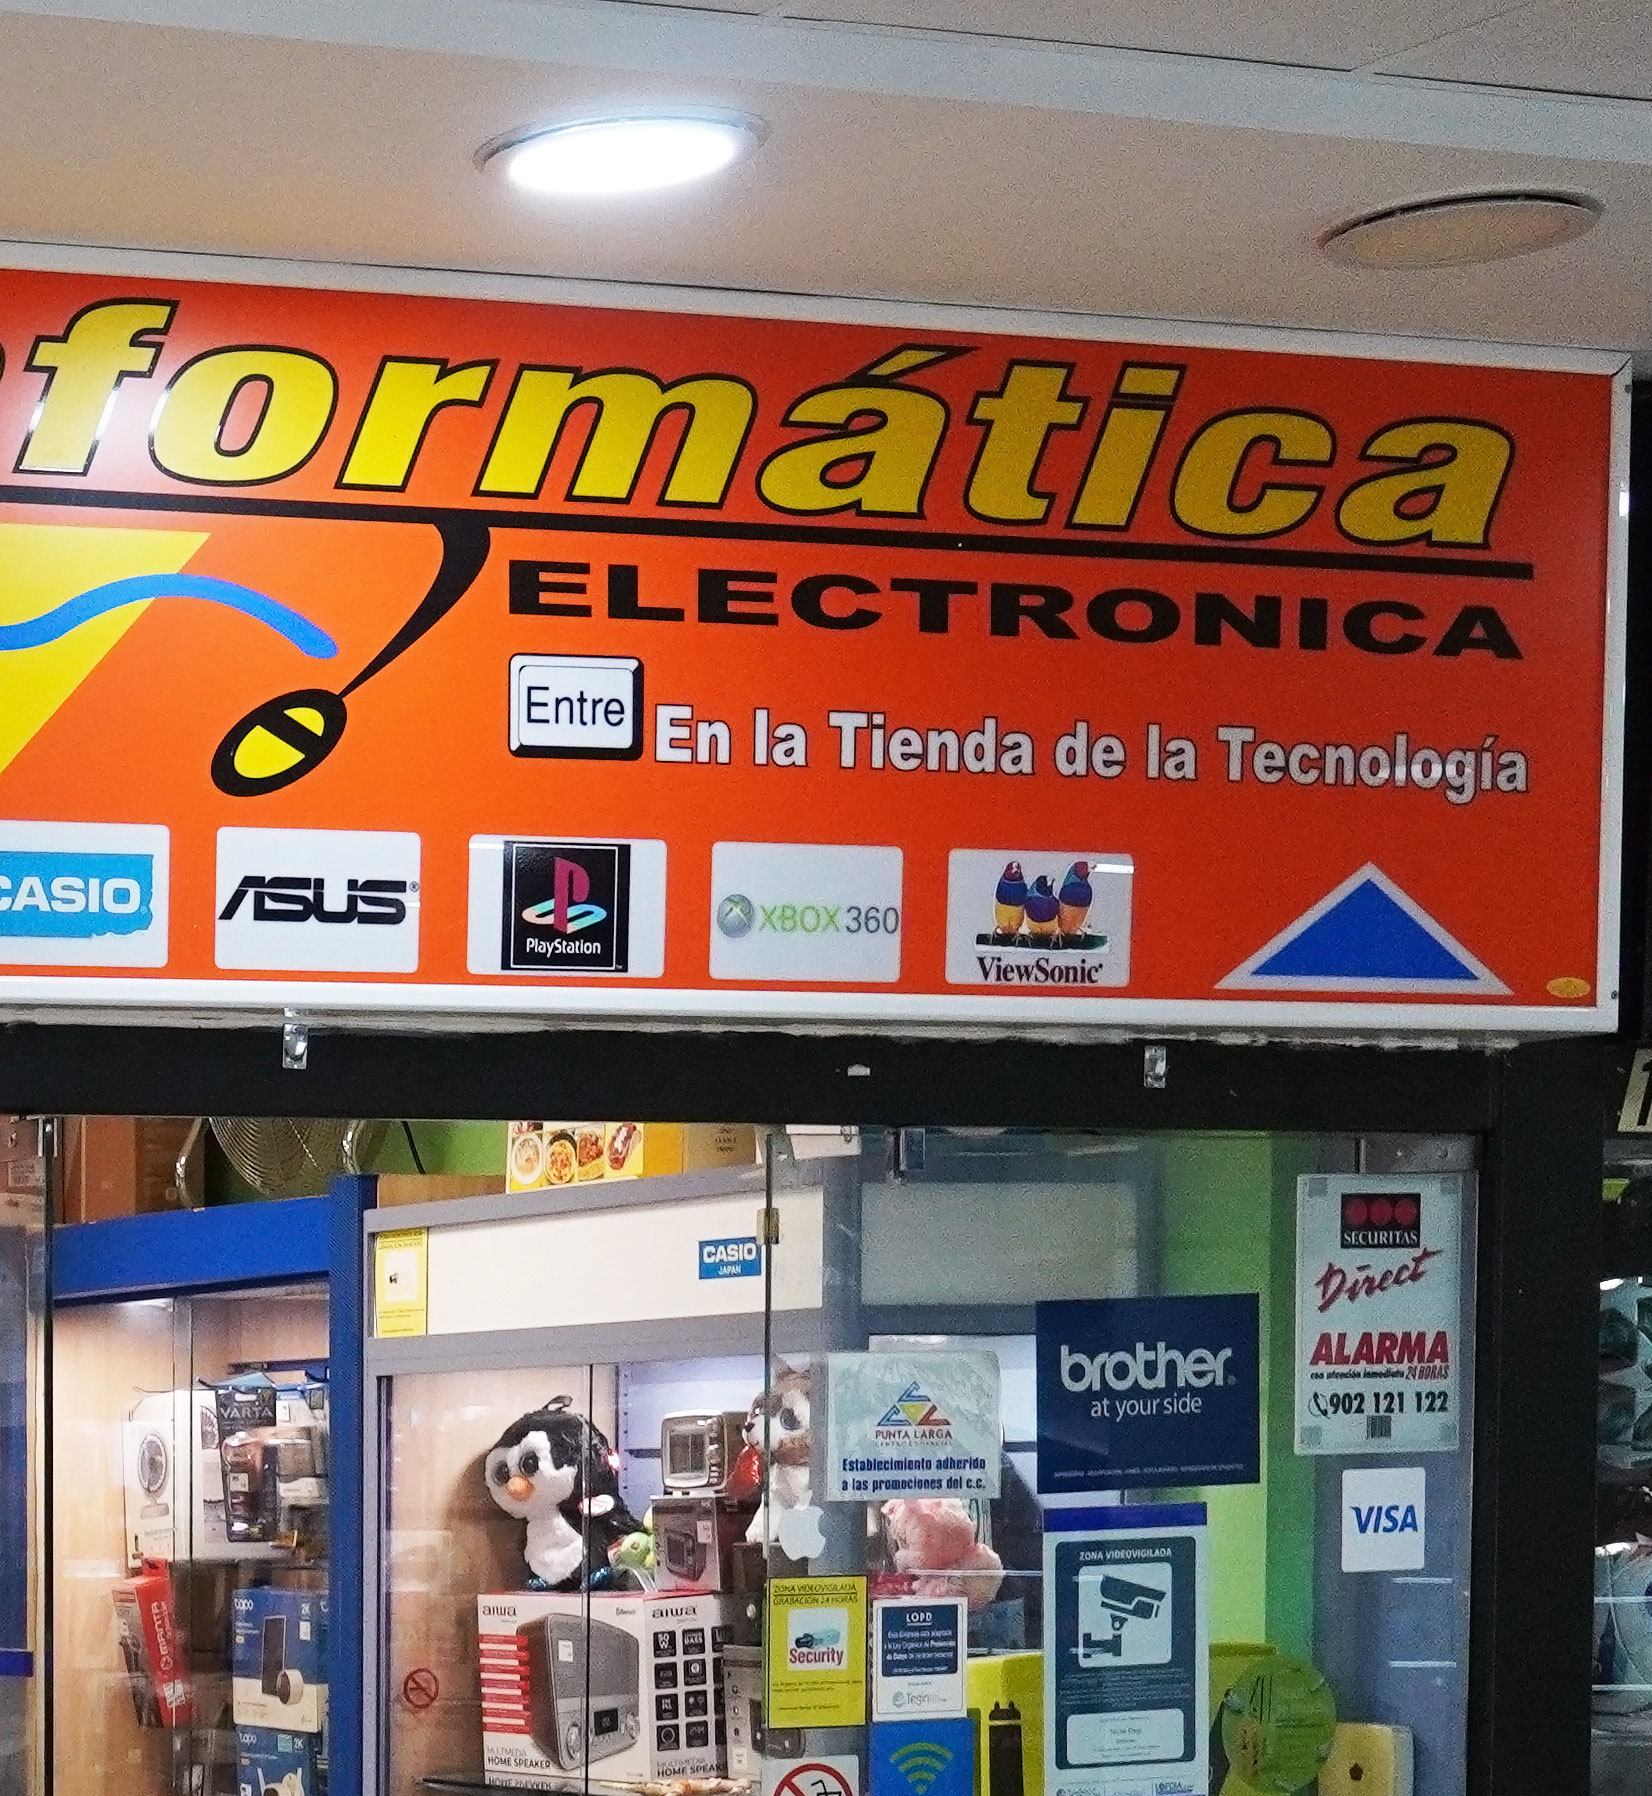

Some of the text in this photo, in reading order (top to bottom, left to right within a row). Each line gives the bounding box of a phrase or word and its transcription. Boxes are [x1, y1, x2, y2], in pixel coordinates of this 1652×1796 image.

[509, 559, 1523, 660] ELECTRONICA
[526, 683, 624, 730] Entre
[654, 705, 1528, 804] En la Tienda de la Tecnología
[219, 877, 406, 924] ASUS
[758, 904, 899, 935] XBOX 360
[526, 936, 601, 957] PlayStation
[977, 957, 1099, 984] ViewSonic
[1344, 1229, 1418, 1246] SECURITAS
[704, 1243, 757, 1263] CASIO
[718, 1265, 741, 1275] JAPAN
[1315, 1248, 1443, 1312] Direct
[1310, 1332, 1448, 1364] ALARMA
[1061, 1343, 1231, 1391] brother
[1090, 1393, 1201, 1419] at your side
[1329, 1391, 1448, 1414] 902 121 122
[875, 1429, 953, 1442] PUNTA LARGA
[843, 1457, 986, 1473] Establecimiento adherido
[841, 1478, 986, 1495] a las promociones del c.c.
[1353, 1506, 1417, 1534] VISA
[1079, 1547, 1173, 1562] ZONA VIDEOVIGILADA
[483, 1605, 516, 1616] aiwa
[789, 1647, 844, 1667] Security
